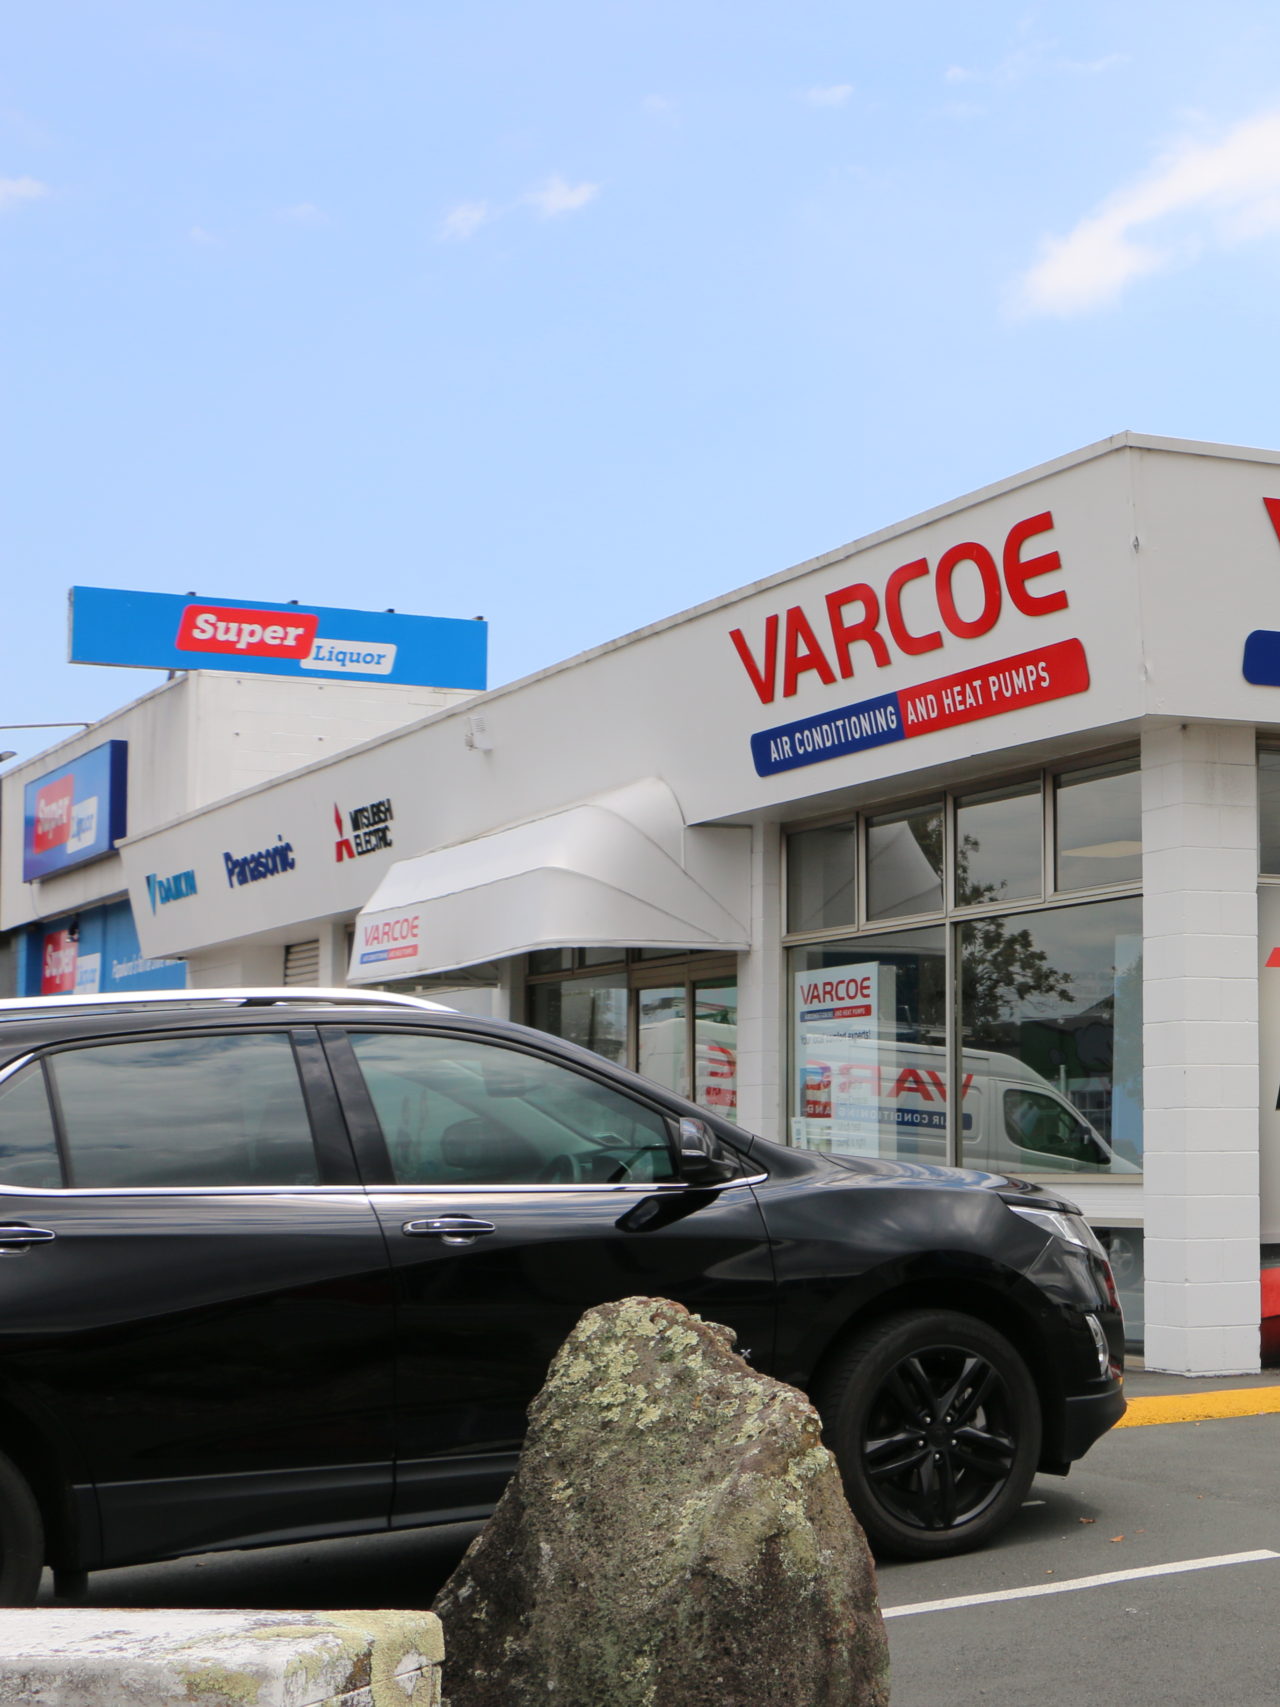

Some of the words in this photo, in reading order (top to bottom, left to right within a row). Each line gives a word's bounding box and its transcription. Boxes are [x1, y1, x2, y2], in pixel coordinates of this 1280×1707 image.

[728, 510, 1069, 705] VARCOE
[191, 612, 305, 650] Super
[313, 644, 387, 667] Liquor
[769, 735, 793, 763] AIR
[793, 705, 898, 756] CONDITIONING
[906, 697, 939, 726] AND
[944, 679, 984, 716] HEAT
[990, 661, 1051, 702] PUMPS
[222, 834, 295, 889] Panasonic
[353, 825, 393, 857] ELECTRIC
[156, 869, 198, 905] DAIKIN
[364, 915, 420, 947] VARCOE
[800, 976, 871, 1006] VARCOE
